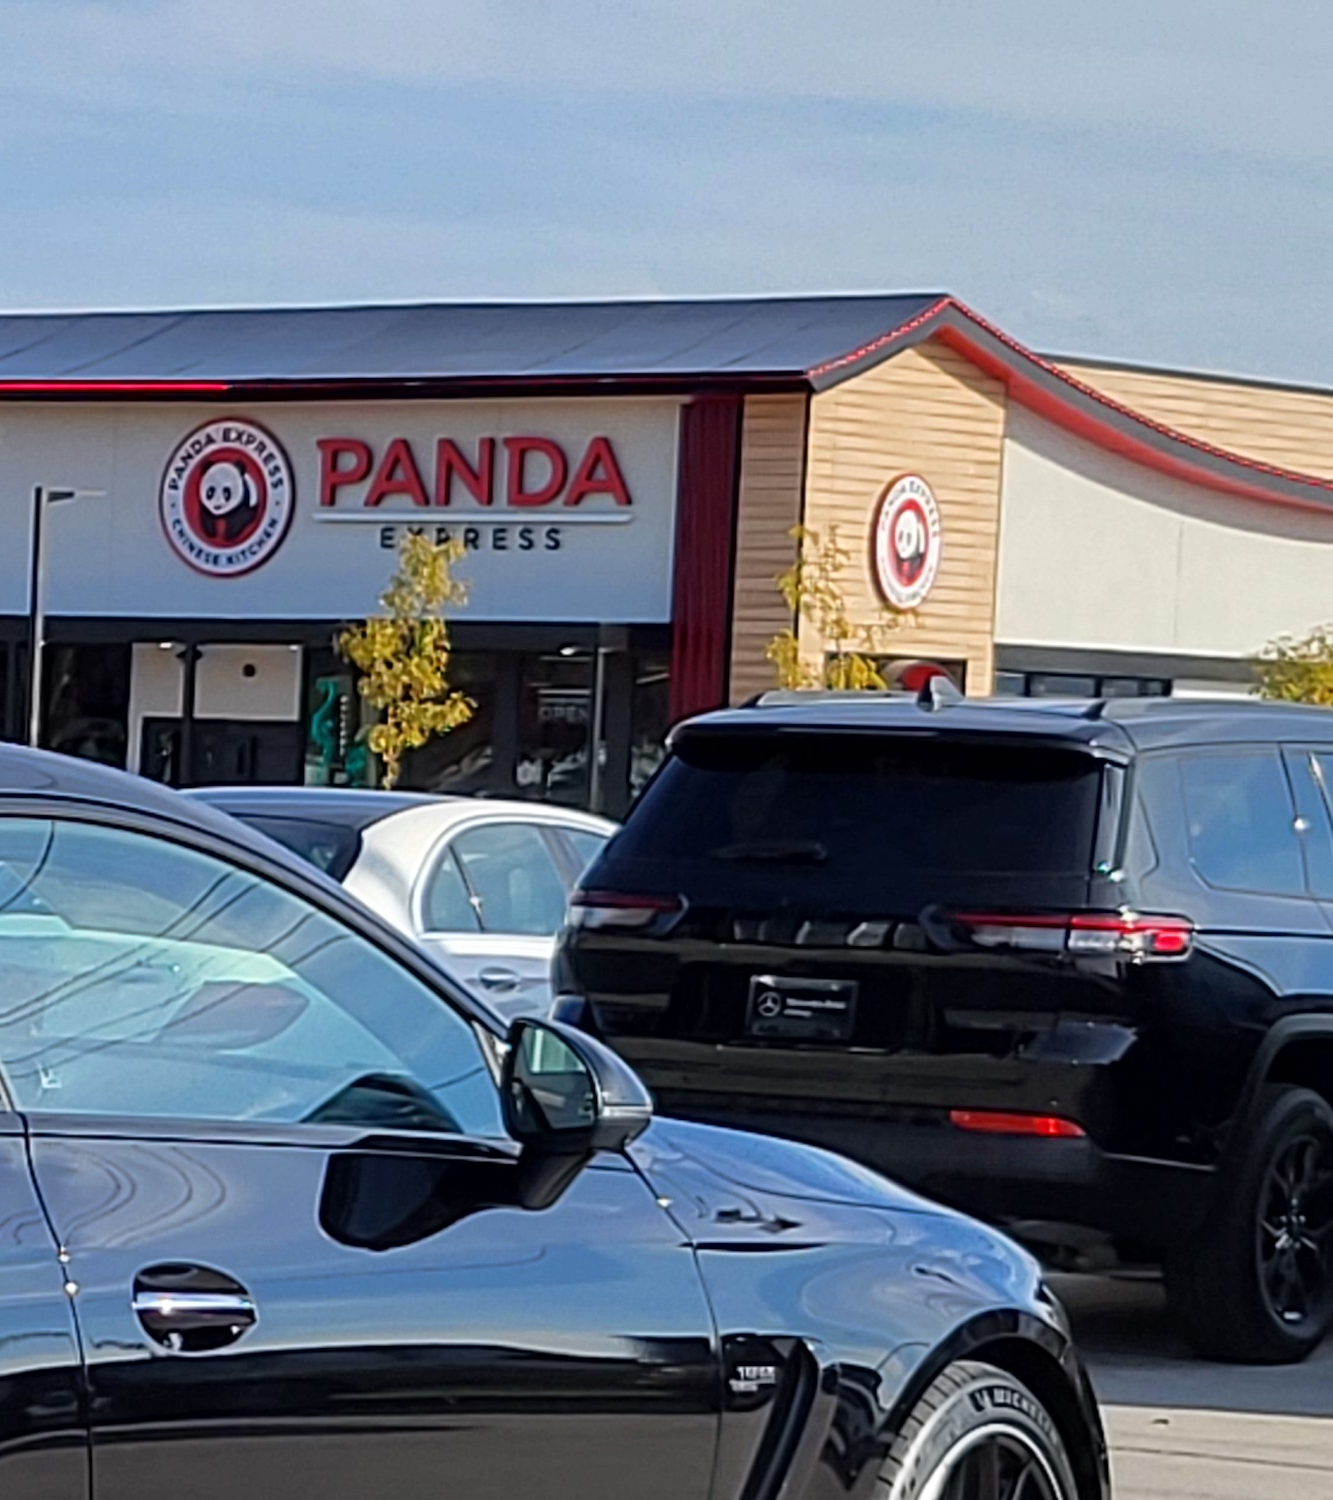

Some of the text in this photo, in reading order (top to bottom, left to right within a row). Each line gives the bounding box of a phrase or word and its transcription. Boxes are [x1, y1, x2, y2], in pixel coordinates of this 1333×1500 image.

[168, 427, 283, 491] PANDA EXPRESS
[316, 436, 633, 507] PANDA
[172, 518, 278, 565] CHINESE KITCHEN
